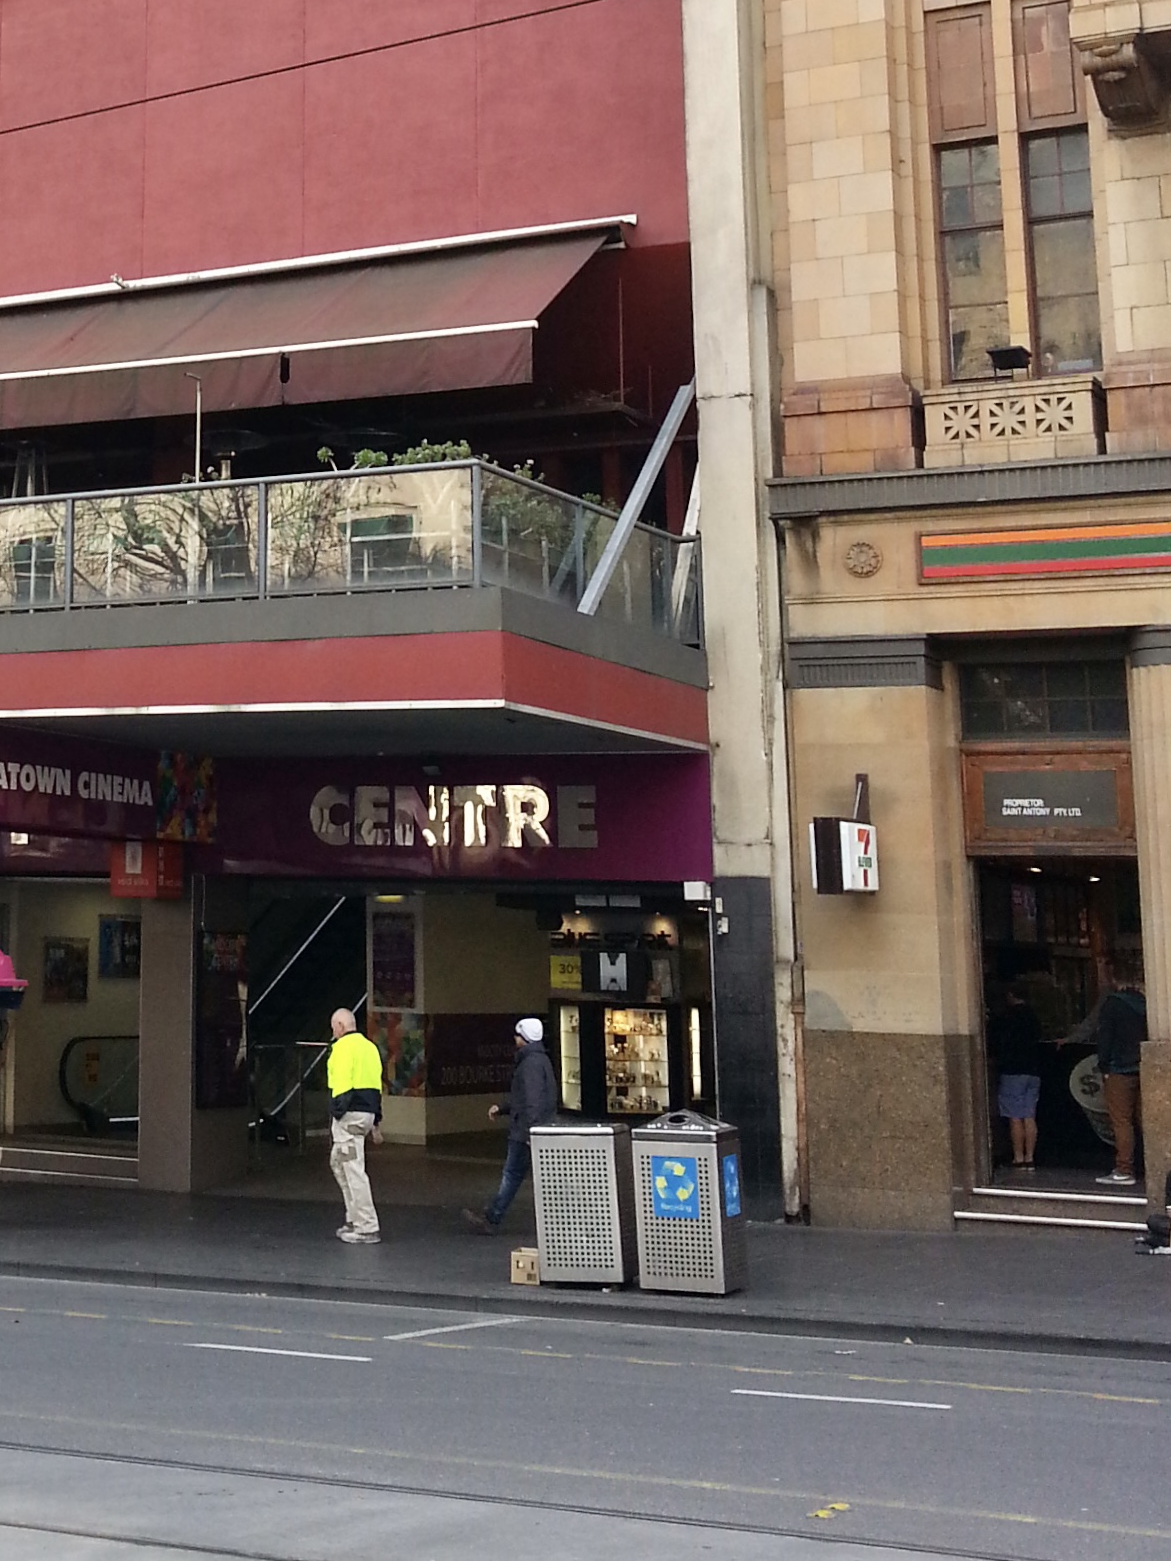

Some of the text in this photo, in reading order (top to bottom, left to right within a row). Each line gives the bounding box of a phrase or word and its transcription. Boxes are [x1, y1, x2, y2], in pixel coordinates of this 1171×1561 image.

[79, 770, 154, 806] CINEMA
[309, 785, 599, 848] CENTRE
[1002, 807, 1022, 816] SAINT
[1022, 807, 1050, 816] ANTONY
